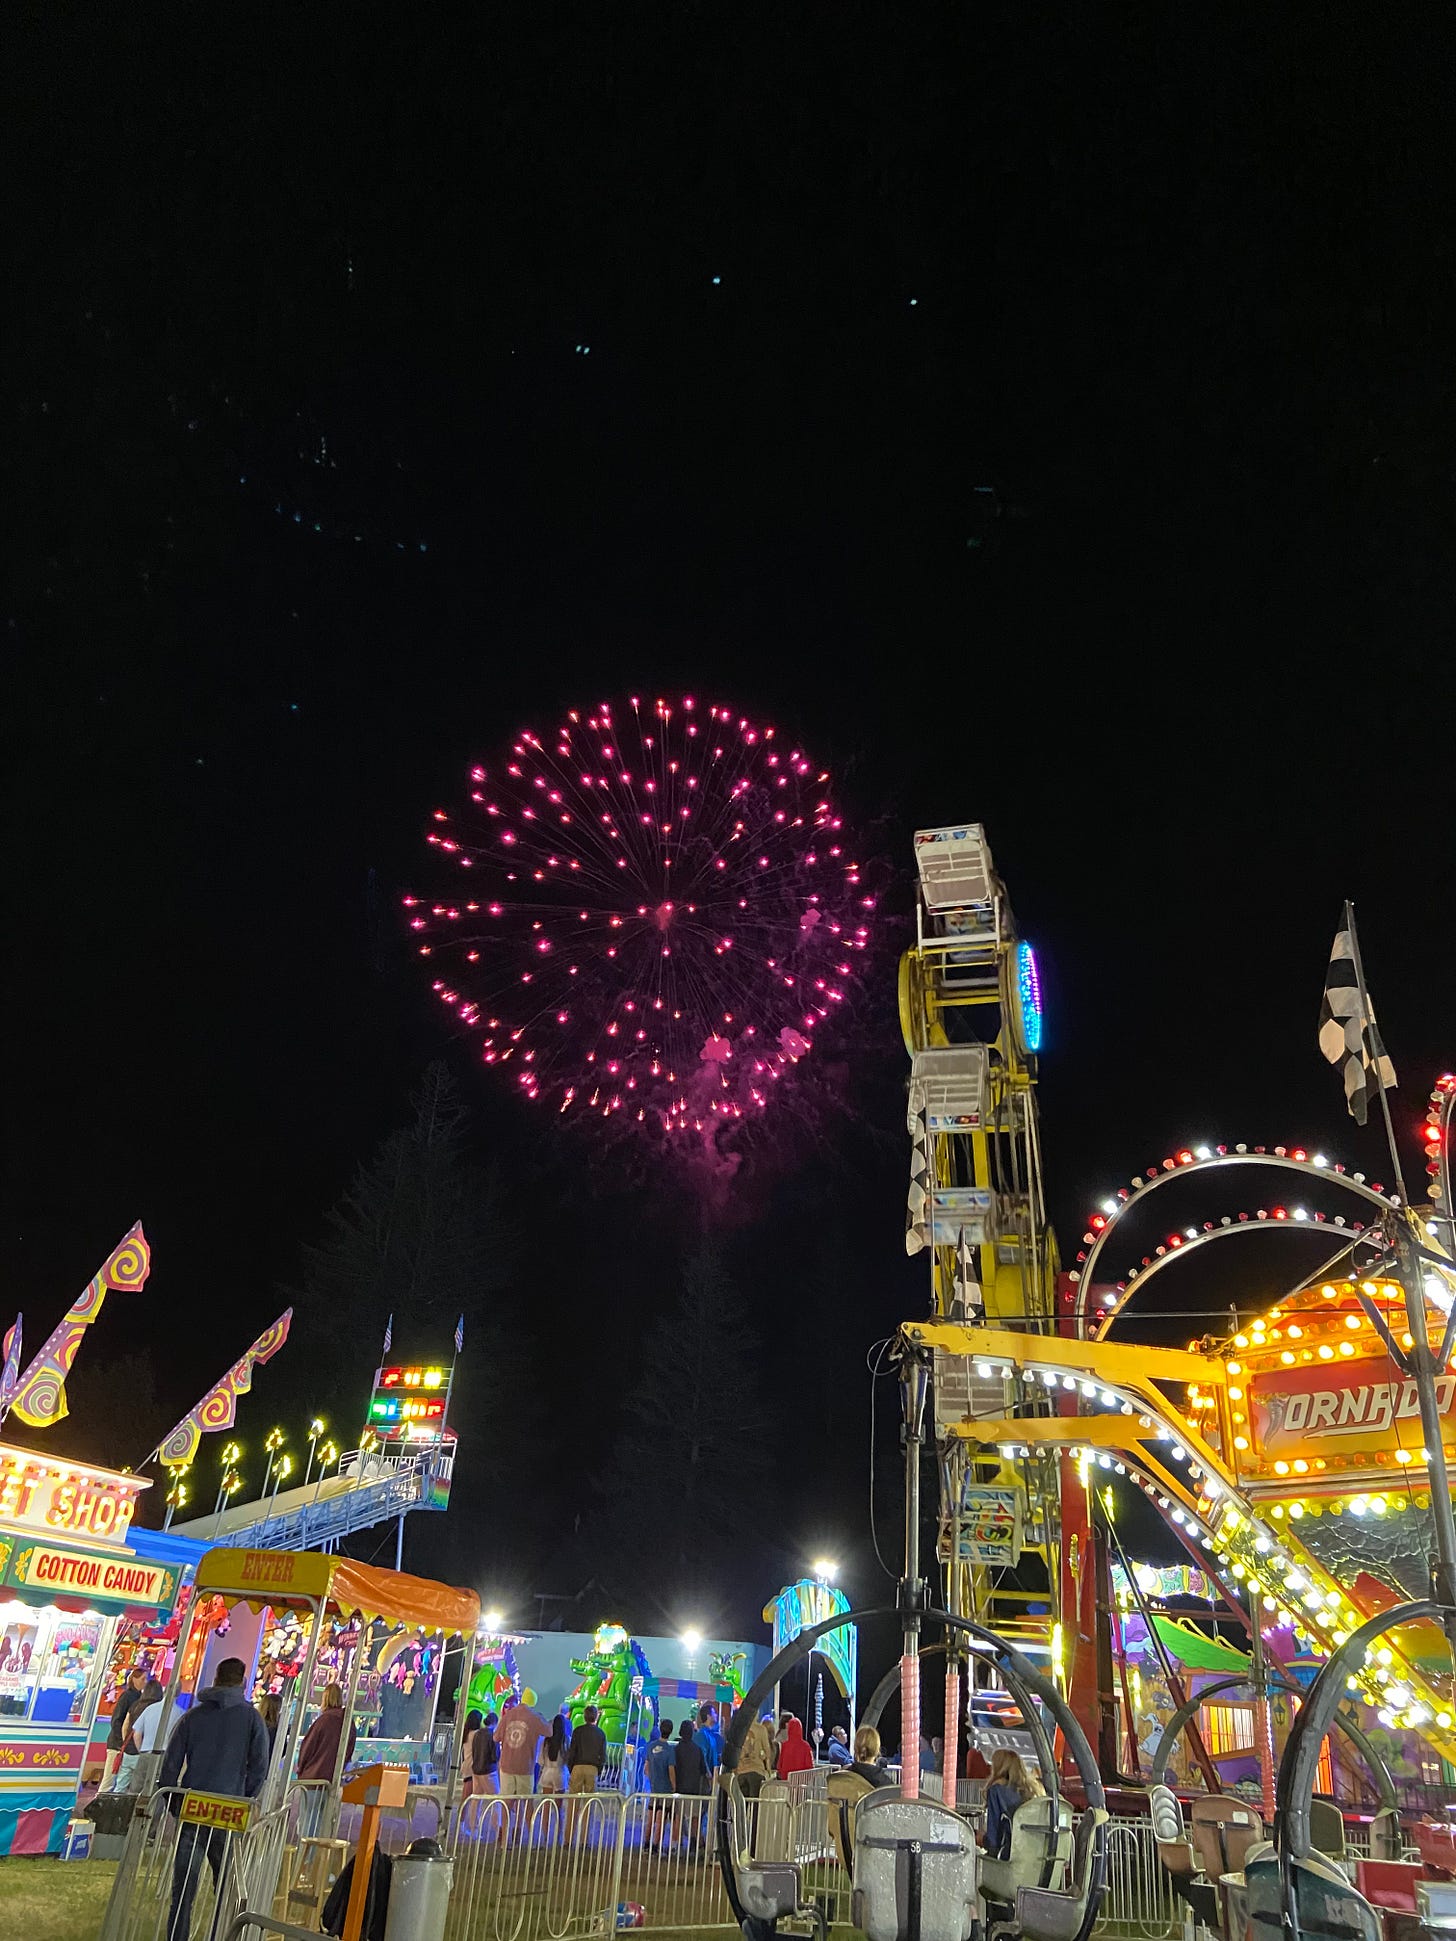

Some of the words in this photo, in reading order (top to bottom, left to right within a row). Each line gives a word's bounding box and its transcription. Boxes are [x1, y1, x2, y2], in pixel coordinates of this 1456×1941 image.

[46, 1482, 135, 1536] SHOP
[36, 1554, 101, 1587] COTTON
[103, 1565, 157, 1594] CANDY
[241, 1552, 295, 1582] ENTER
[186, 1799, 244, 1825] ENTER
